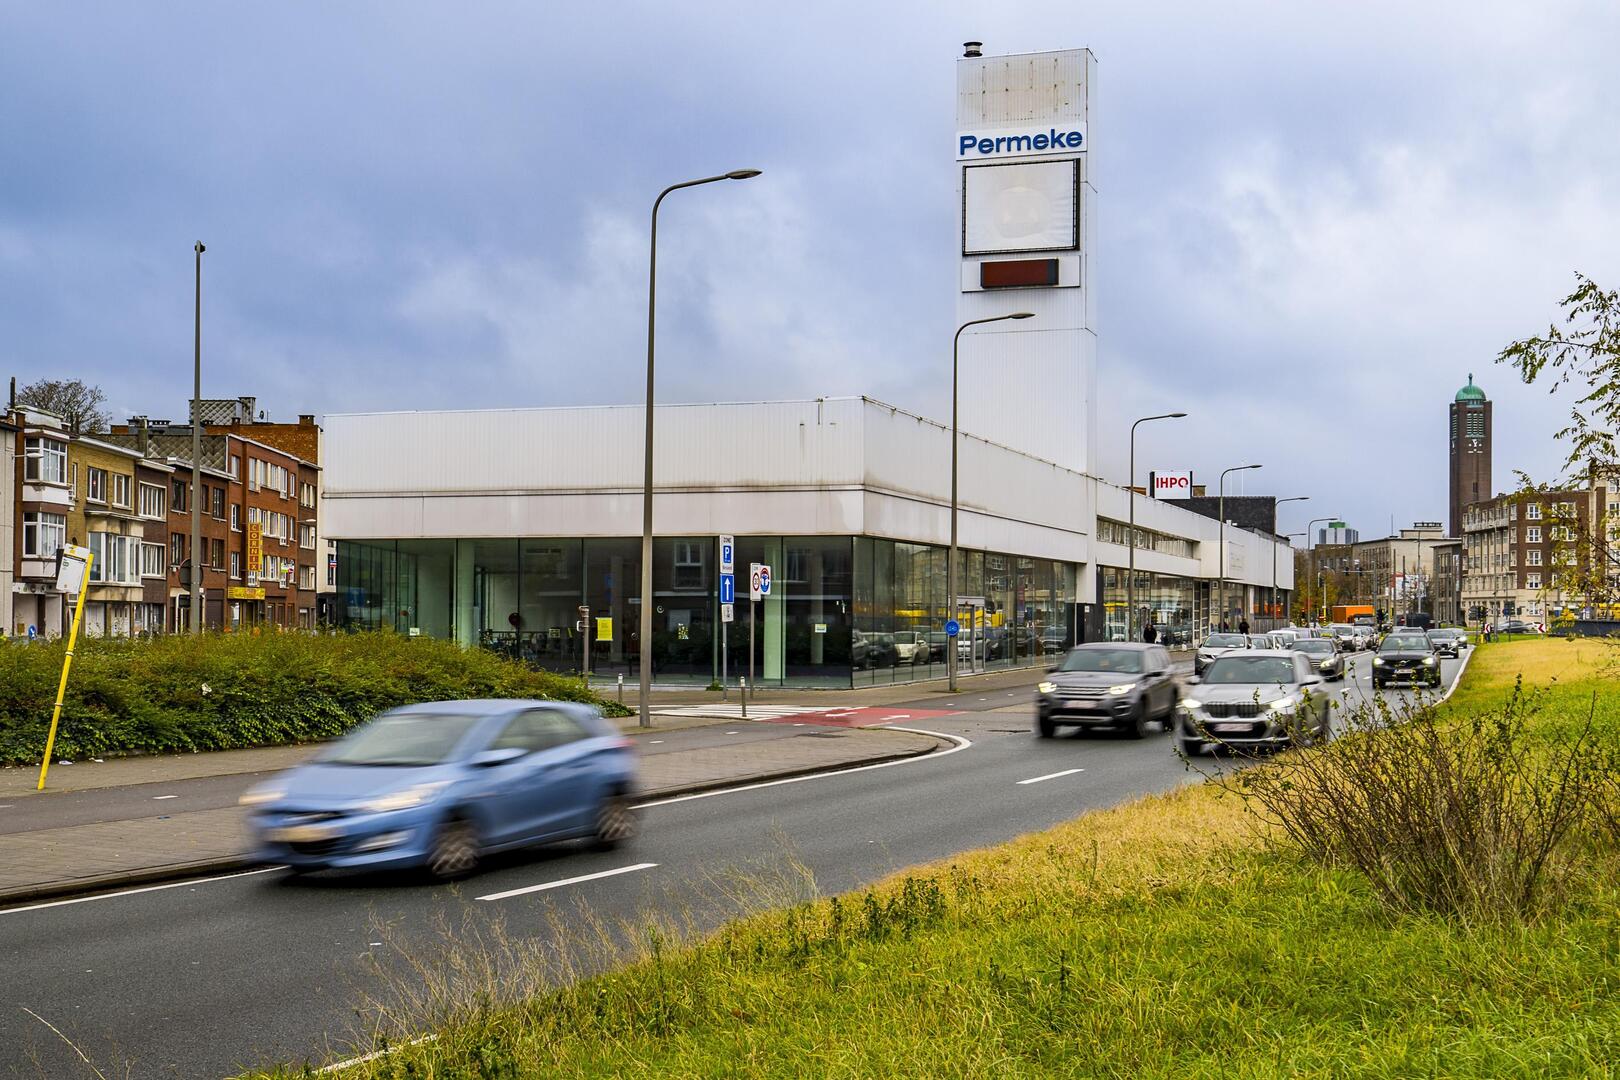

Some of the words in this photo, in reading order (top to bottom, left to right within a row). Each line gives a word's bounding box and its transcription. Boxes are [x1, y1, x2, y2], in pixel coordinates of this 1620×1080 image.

[960, 128, 1083, 156] Permeke
[250, 524, 259, 571] CORNIX
[724, 546, 730, 558] P
